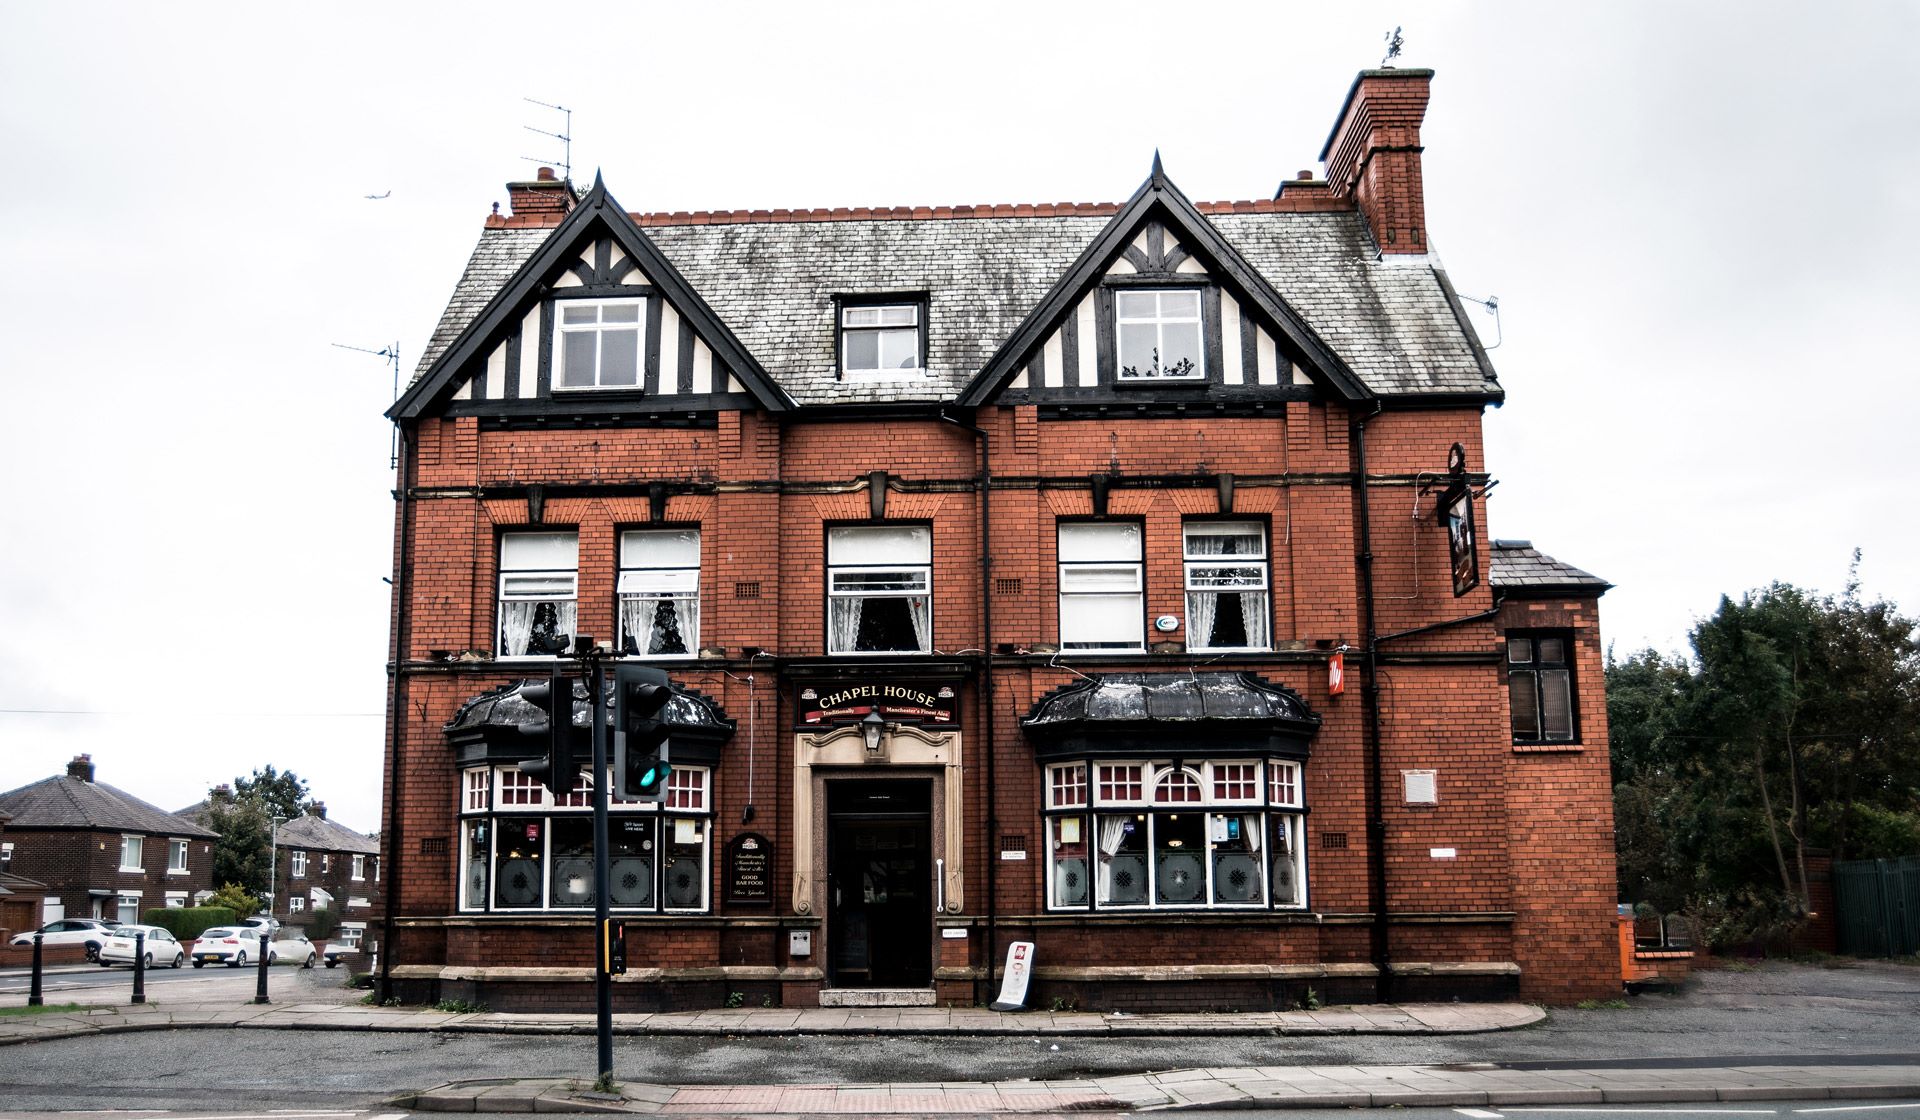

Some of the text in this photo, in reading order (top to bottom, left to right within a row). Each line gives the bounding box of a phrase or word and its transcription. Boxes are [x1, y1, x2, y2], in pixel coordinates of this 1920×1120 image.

[1329, 660, 1341, 691] illy
[820, 685, 936, 709] CHAPEL HOUSE
[823, 708, 854, 716] Traditionally
